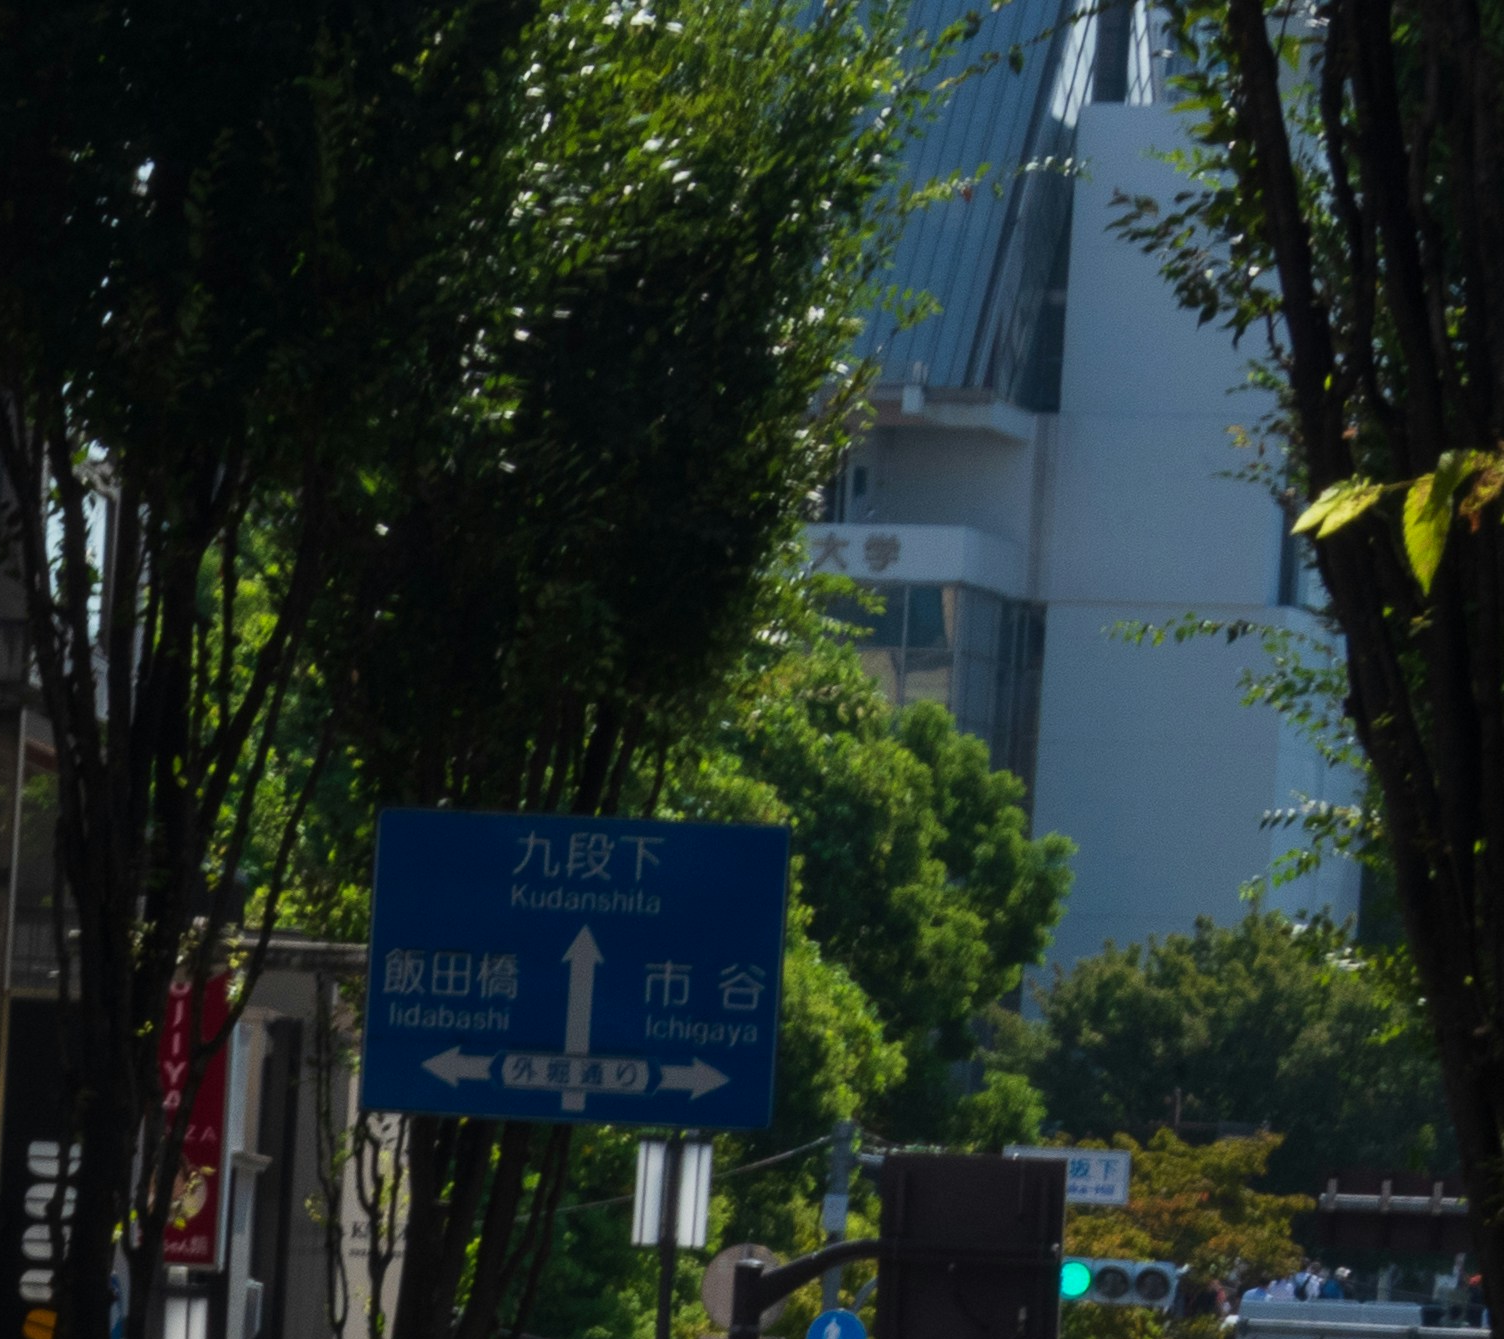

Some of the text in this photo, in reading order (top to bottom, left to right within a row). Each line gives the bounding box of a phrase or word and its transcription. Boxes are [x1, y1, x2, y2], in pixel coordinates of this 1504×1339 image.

[512, 830, 665, 881] 九段下
[510, 884, 662, 914] Kudanshita
[382, 947, 766, 1012] 飯田橋 市谷
[389, 1001, 759, 1047] Iidabashi Ichigaya
[510, 1060, 641, 1088] 外堀通り
